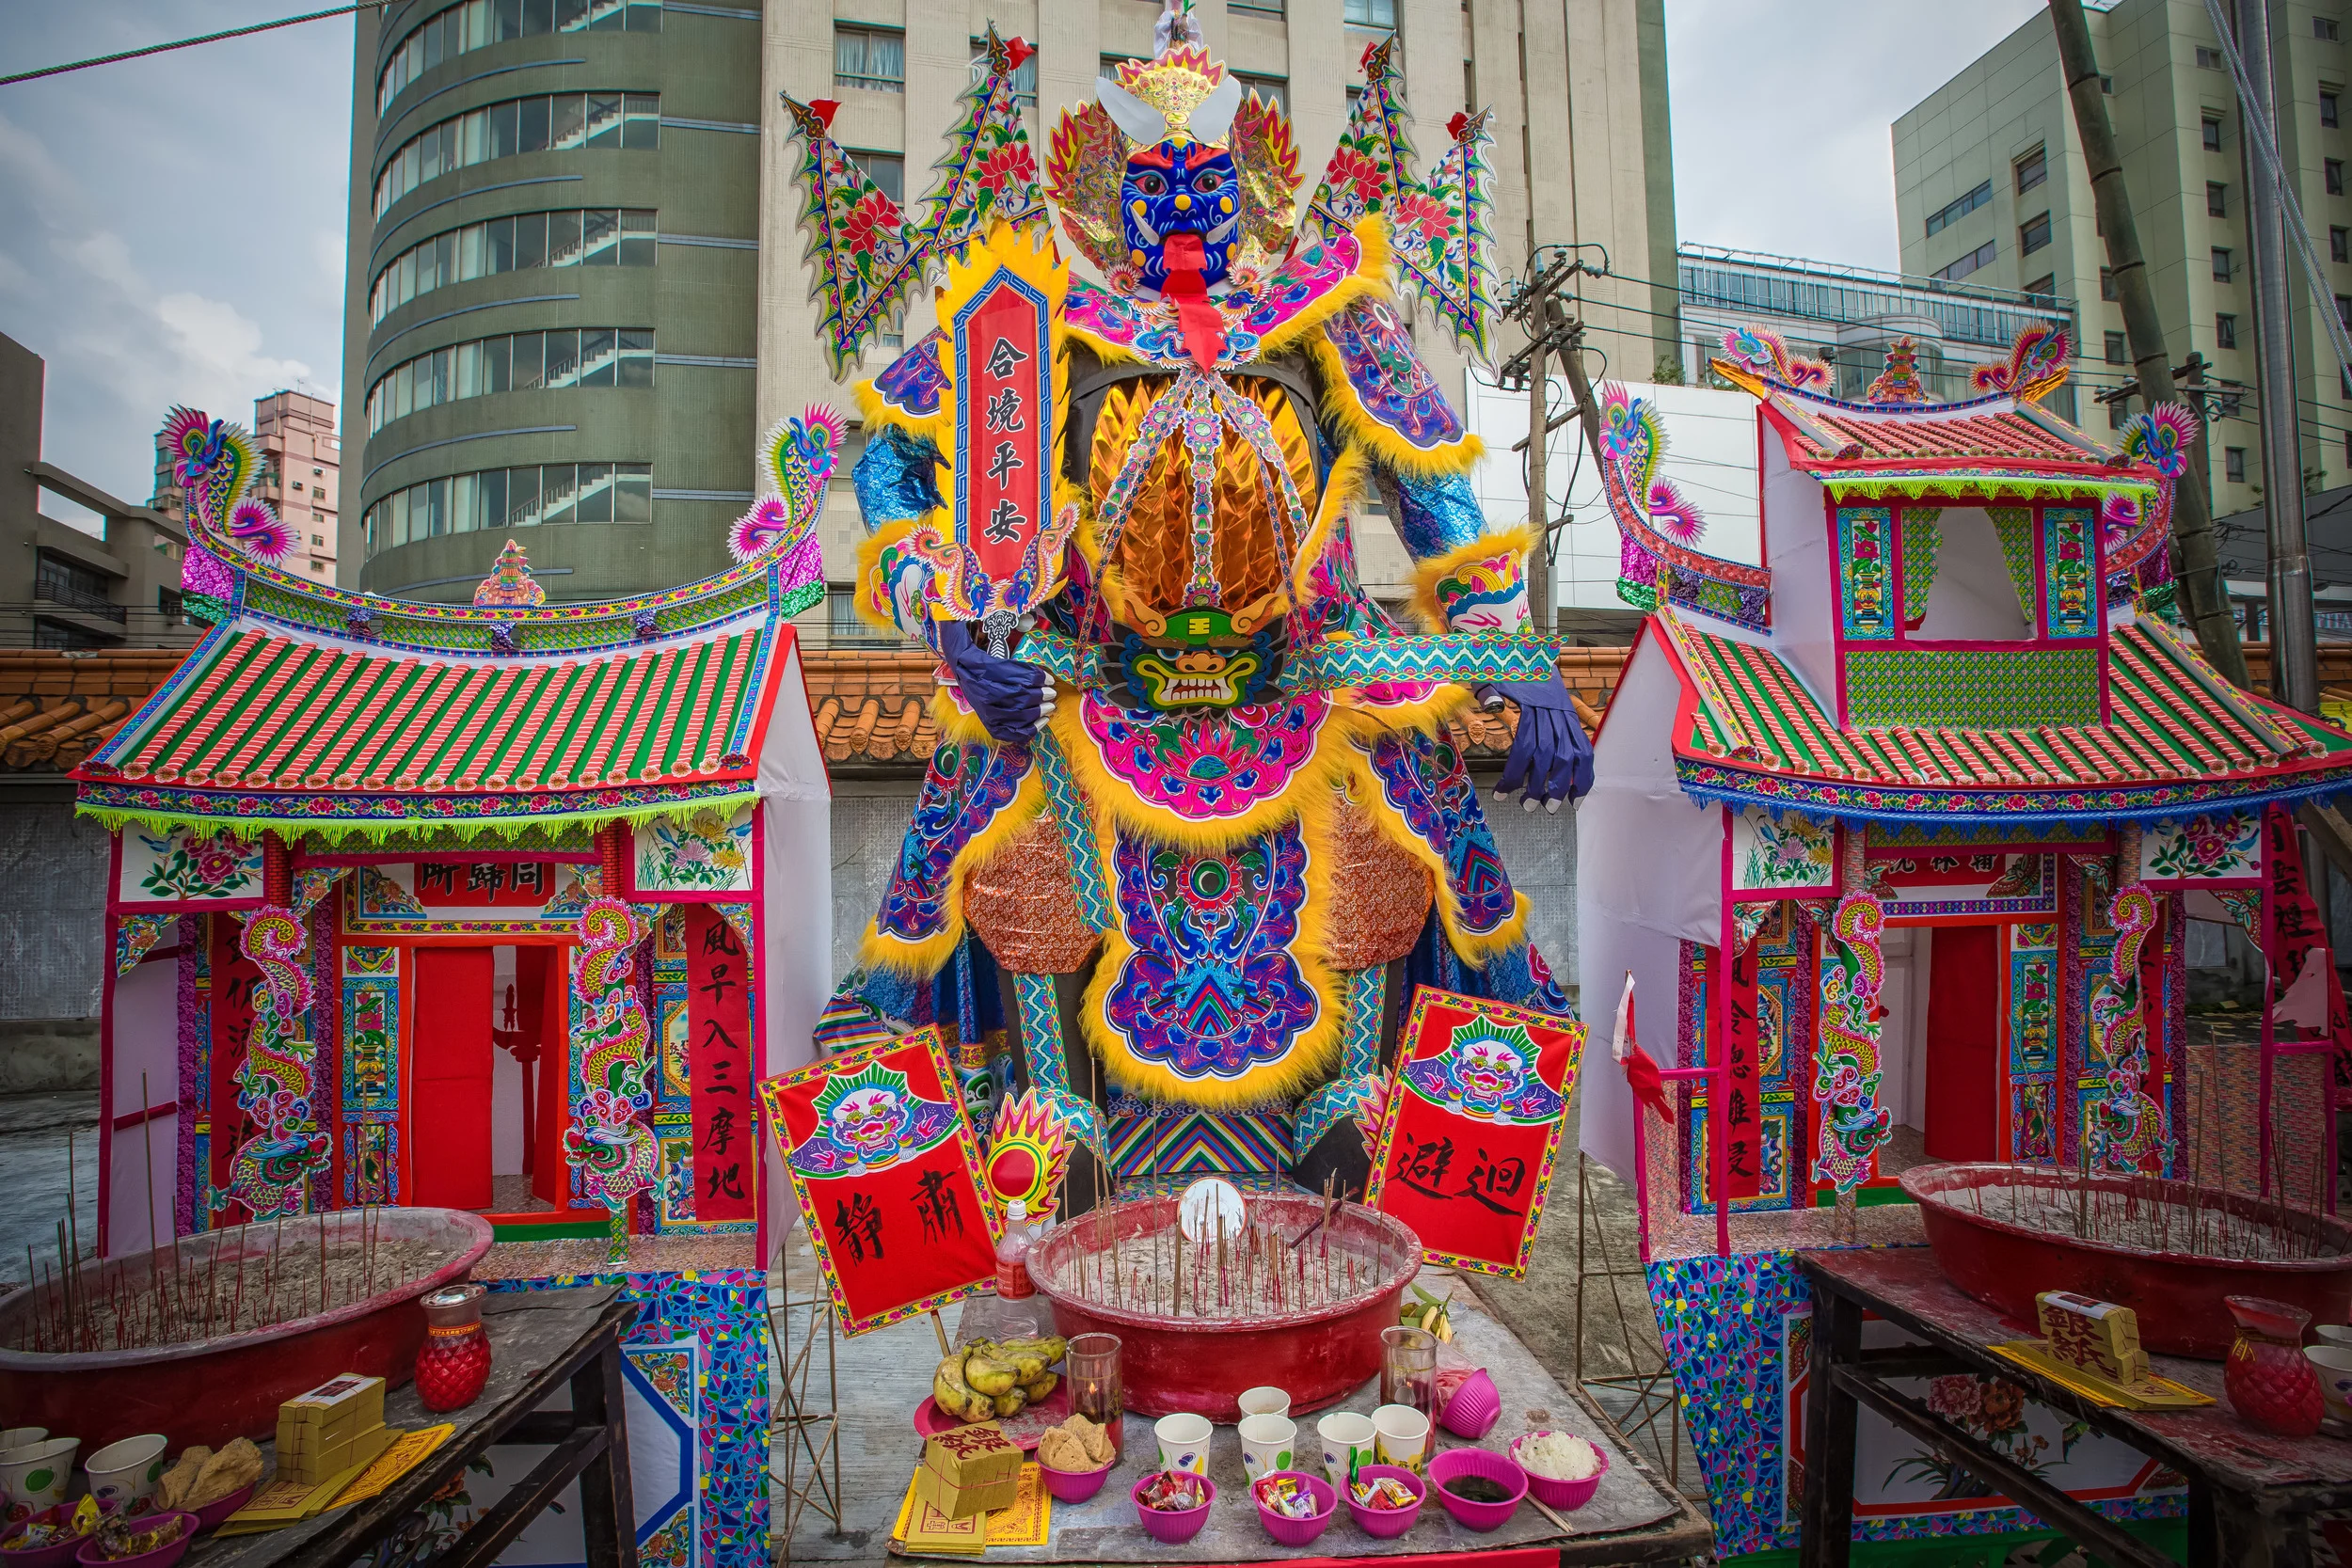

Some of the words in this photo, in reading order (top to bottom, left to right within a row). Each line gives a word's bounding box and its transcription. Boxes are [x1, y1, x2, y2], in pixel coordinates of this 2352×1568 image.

[983, 337, 1027, 545] 合境平安
[1188, 617, 1210, 635] 王
[699, 904, 746, 1201] 風早入三摩地
[2042, 1306, 2118, 1379] 銀紙
